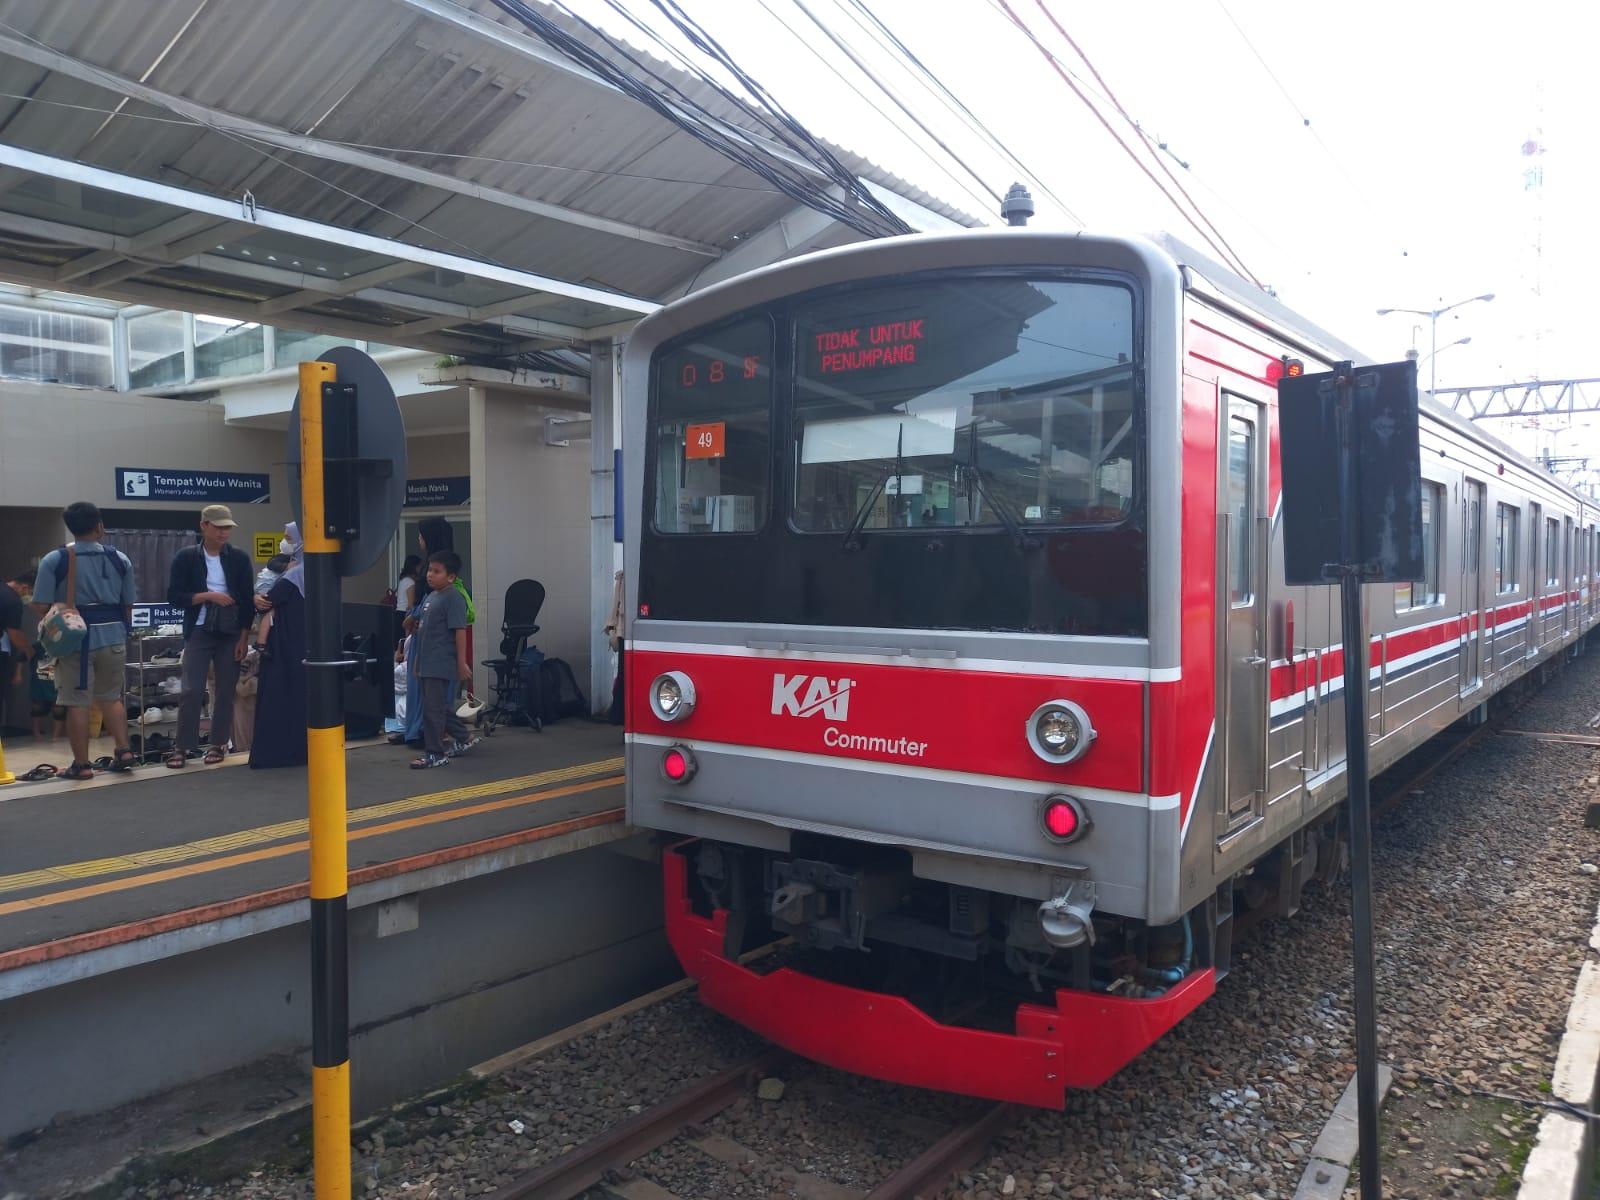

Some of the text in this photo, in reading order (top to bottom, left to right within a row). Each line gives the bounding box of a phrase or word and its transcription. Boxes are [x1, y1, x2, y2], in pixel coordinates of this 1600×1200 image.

[816, 319, 923, 352] TIDAK UNTUK
[822, 343, 916, 373] PENUMPANG
[697, 432, 713, 448] 49
[154, 475, 262, 489] Tempat Wudu Wanita
[154, 608, 170, 617] Rak
[771, 673, 857, 722] KAI
[823, 726, 928, 757] Commuter
